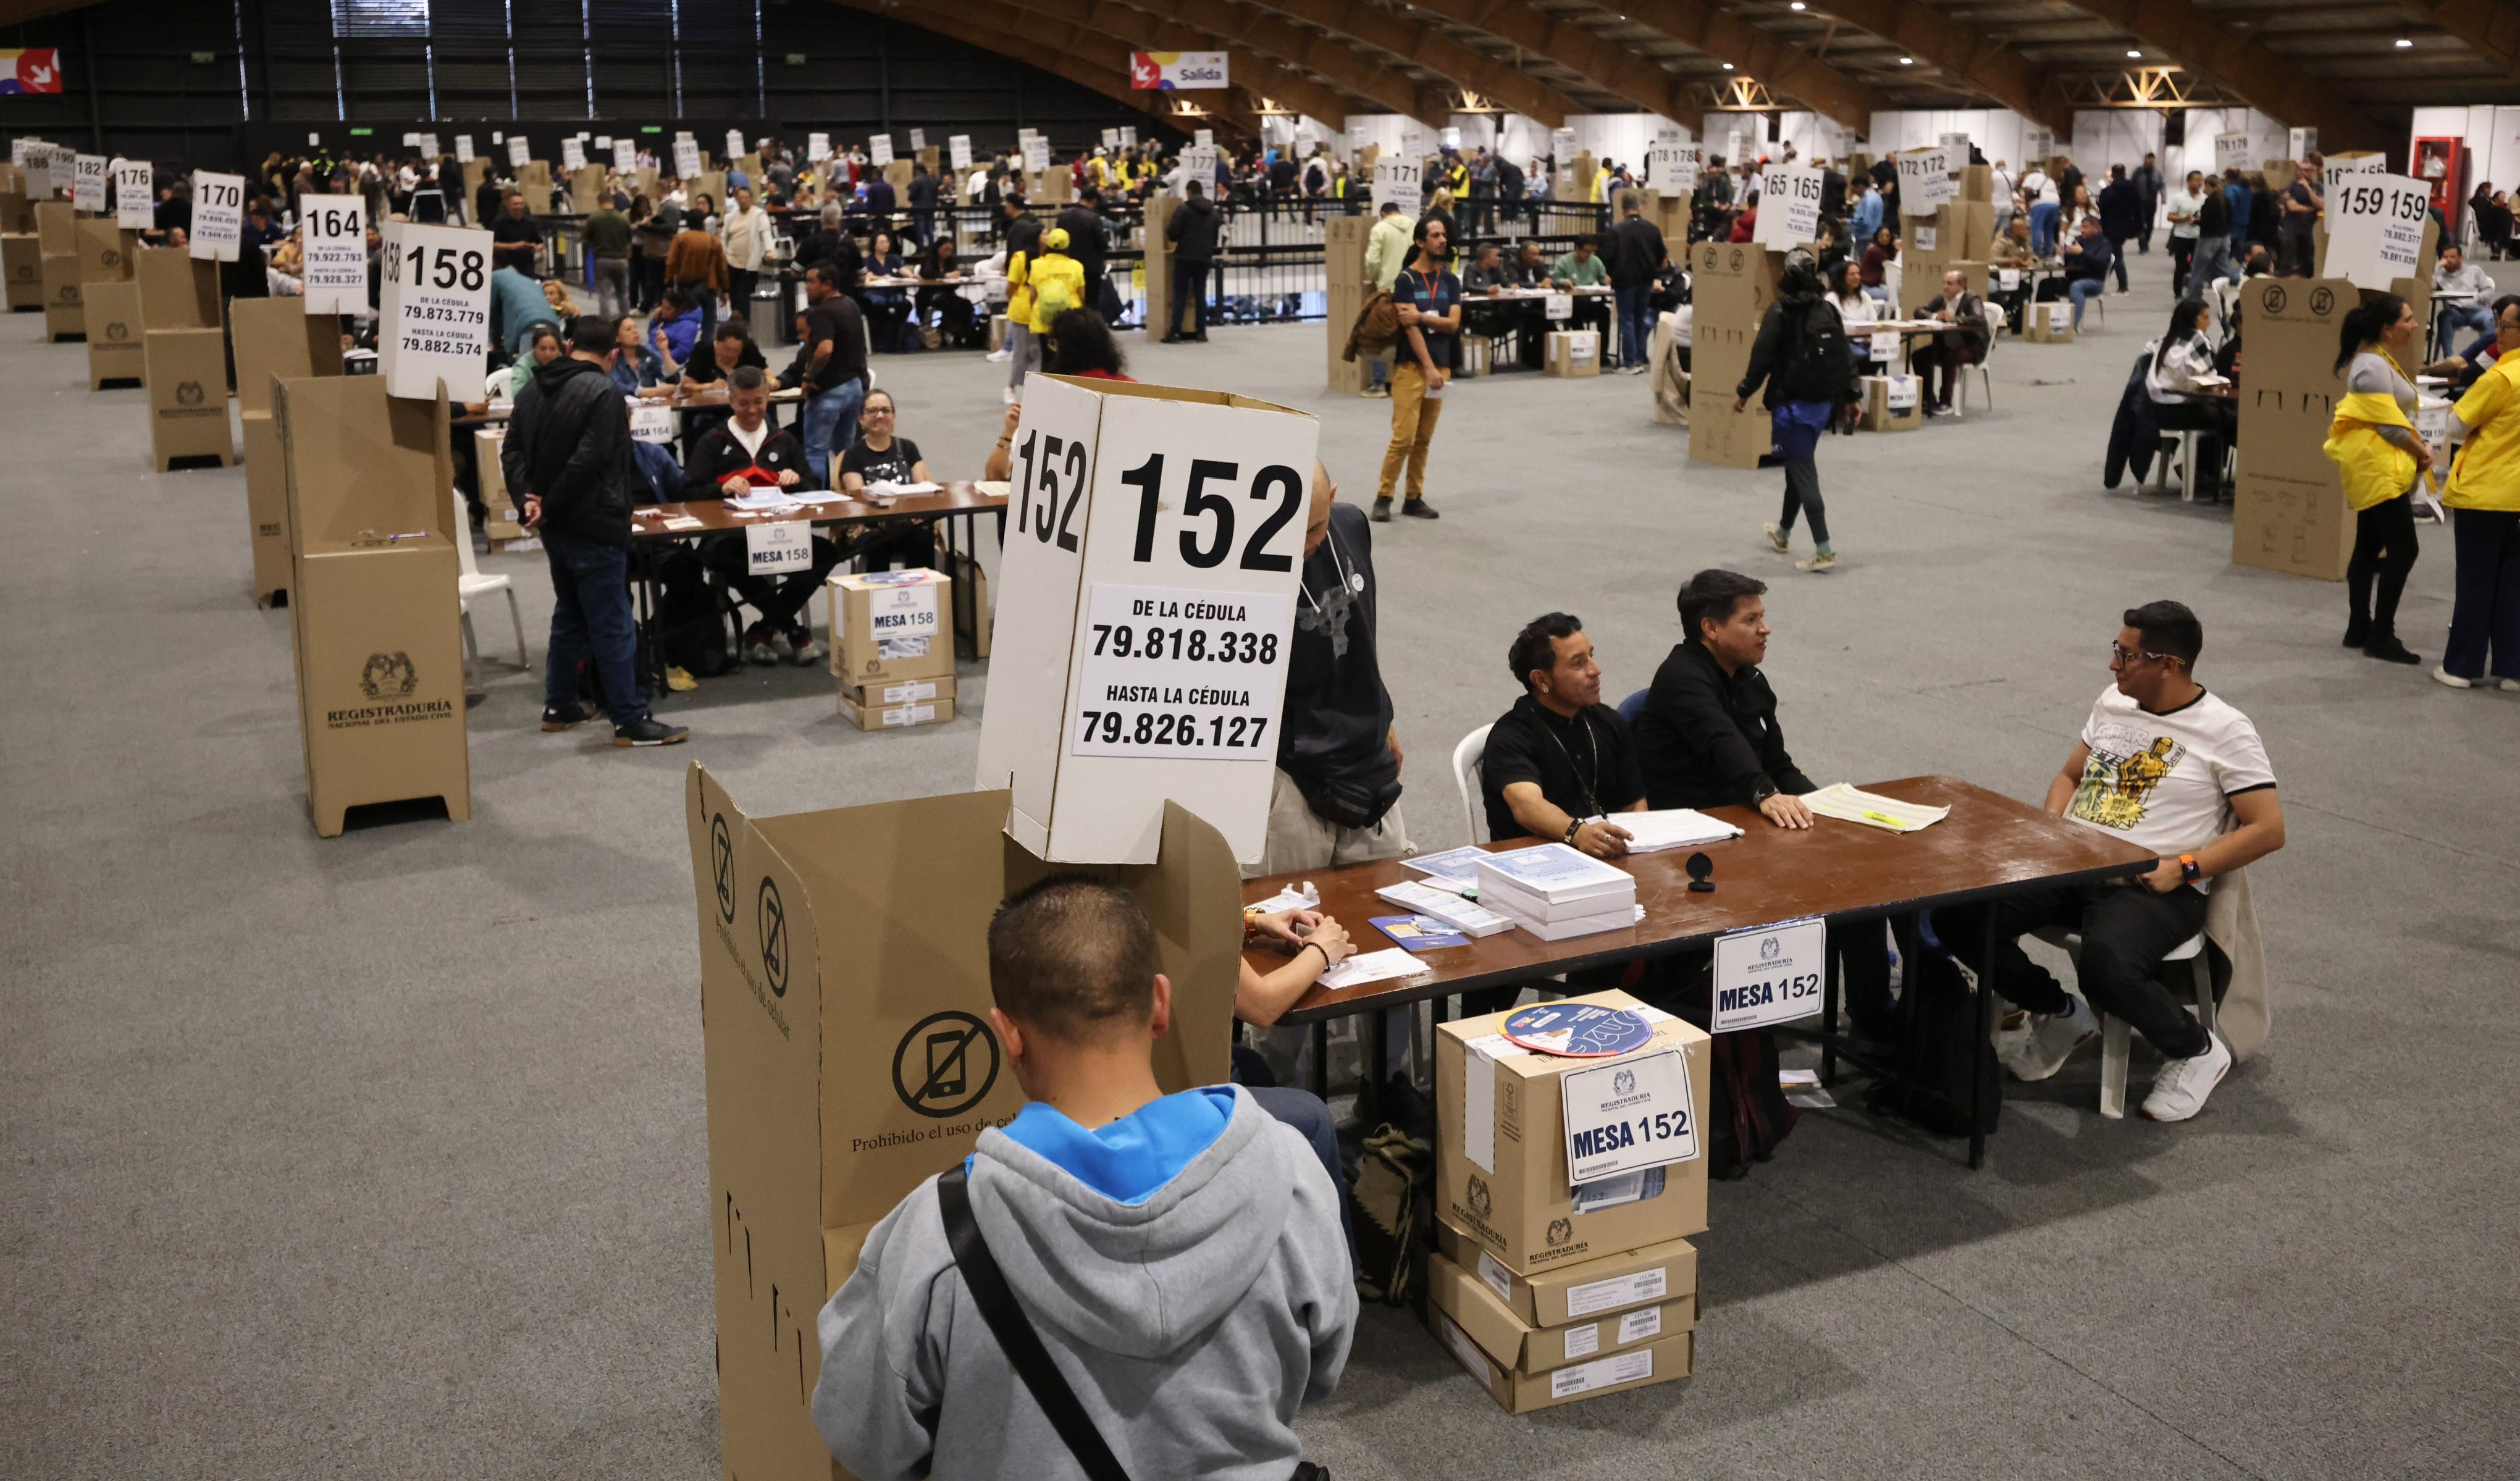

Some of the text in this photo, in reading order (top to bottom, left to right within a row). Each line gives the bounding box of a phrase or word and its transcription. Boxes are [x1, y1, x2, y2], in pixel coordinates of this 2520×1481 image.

[1180, 69, 1221, 80] Salida
[1192, 157, 1214, 170] 177
[1652, 149, 1668, 162] 178
[1673, 149, 1694, 162] 178
[1923, 154, 1945, 174] 172
[78, 162, 101, 175] 182
[120, 170, 149, 185] 176
[1392, 165, 1419, 182] 171
[1899, 161, 1918, 175] 172
[2326, 167, 2354, 186] 16
[1763, 174, 1787, 195] 165
[1794, 176, 1820, 200] 165
[201, 184, 239, 207] 170
[2340, 188, 2384, 214] 159
[2391, 189, 2426, 221] 159
[306, 209, 359, 237] 164
[307, 253, 362, 262] 79.922.793
[383, 241, 400, 283] 158
[407, 246, 484, 292] 158
[308, 275, 362, 284] 79.928.327
[442, 298, 469, 307] CÉDULA
[405, 306, 484, 324] 79.873.779
[447, 330, 473, 340] CÉDULA
[403, 338, 481, 356] 79.882.574
[653, 427, 668, 435] 164
[1018, 429, 1087, 553] 152
[1121, 453, 1303, 573] 152
[752, 548, 808, 564] MESA 158
[875, 612, 934, 628] MESA 158
[1133, 599, 1246, 622] DE LA CÉDULA
[1093, 624, 1279, 665] 79.818.338
[1106, 685, 1250, 707] HASTA LA CÉDULA
[327, 699, 452, 721] REGISTRADURÍA
[1082, 711, 1267, 748] 79.826.127
[1748, 957, 1792, 971] REGISTRADURÍA
[715, 912, 740, 968] Prohibido
[741, 958, 746, 978] el
[758, 982, 766, 1008] de
[768, 1000, 789, 1042] celular
[1720, 973, 1818, 1012] MESA 152
[1601, 1092, 1650, 1109] REGISTRADURÍA
[852, 1131, 925, 1152] Prohibido
[929, 1125, 941, 1139] el
[947, 1124, 971, 1136] uso
[975, 1118, 991, 1131] de
[1573, 1110, 1689, 1159] MESA 152
[1452, 1202, 1507, 1248] REGISTRADURÍA
[1529, 1241, 1588, 1261] REGISTRADURÍA
